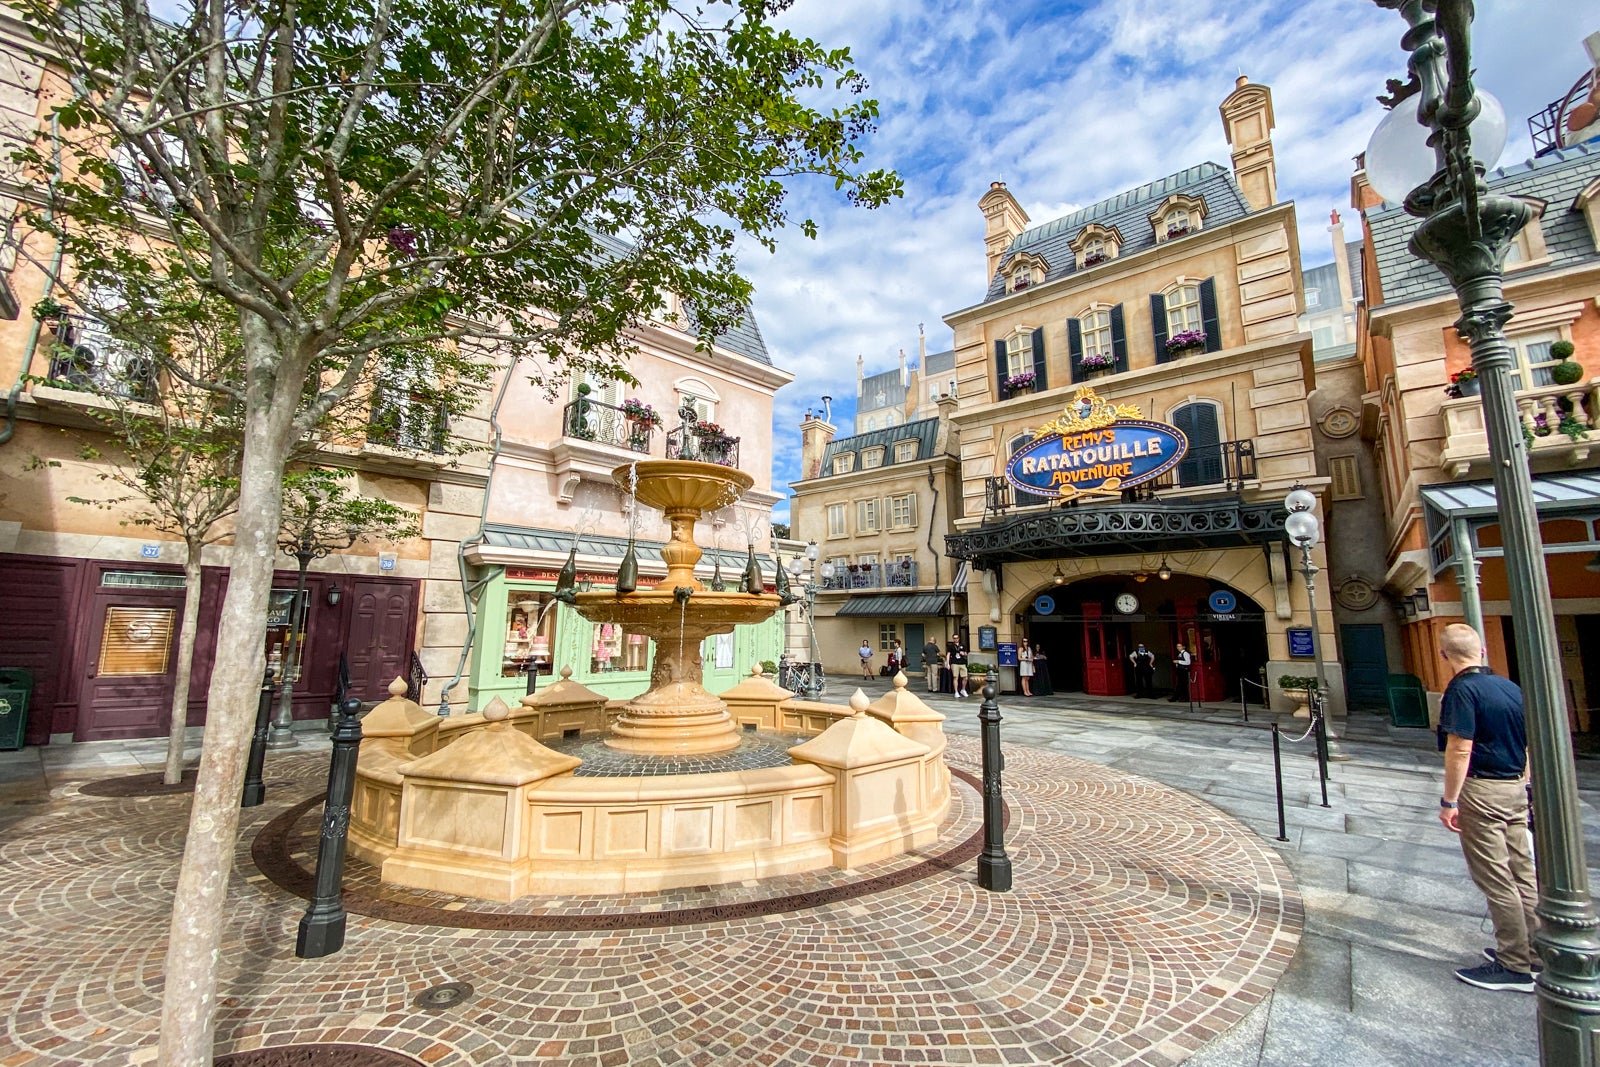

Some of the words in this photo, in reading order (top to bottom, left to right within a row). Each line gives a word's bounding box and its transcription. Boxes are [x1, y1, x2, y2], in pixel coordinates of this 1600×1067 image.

[1062, 429, 1115, 450] REMY'S
[1023, 437, 1162, 474] RATATOUILLE
[1050, 462, 1133, 486] ADVENTURE
[144, 548, 156, 556] 37
[383, 560, 392, 568] 39
